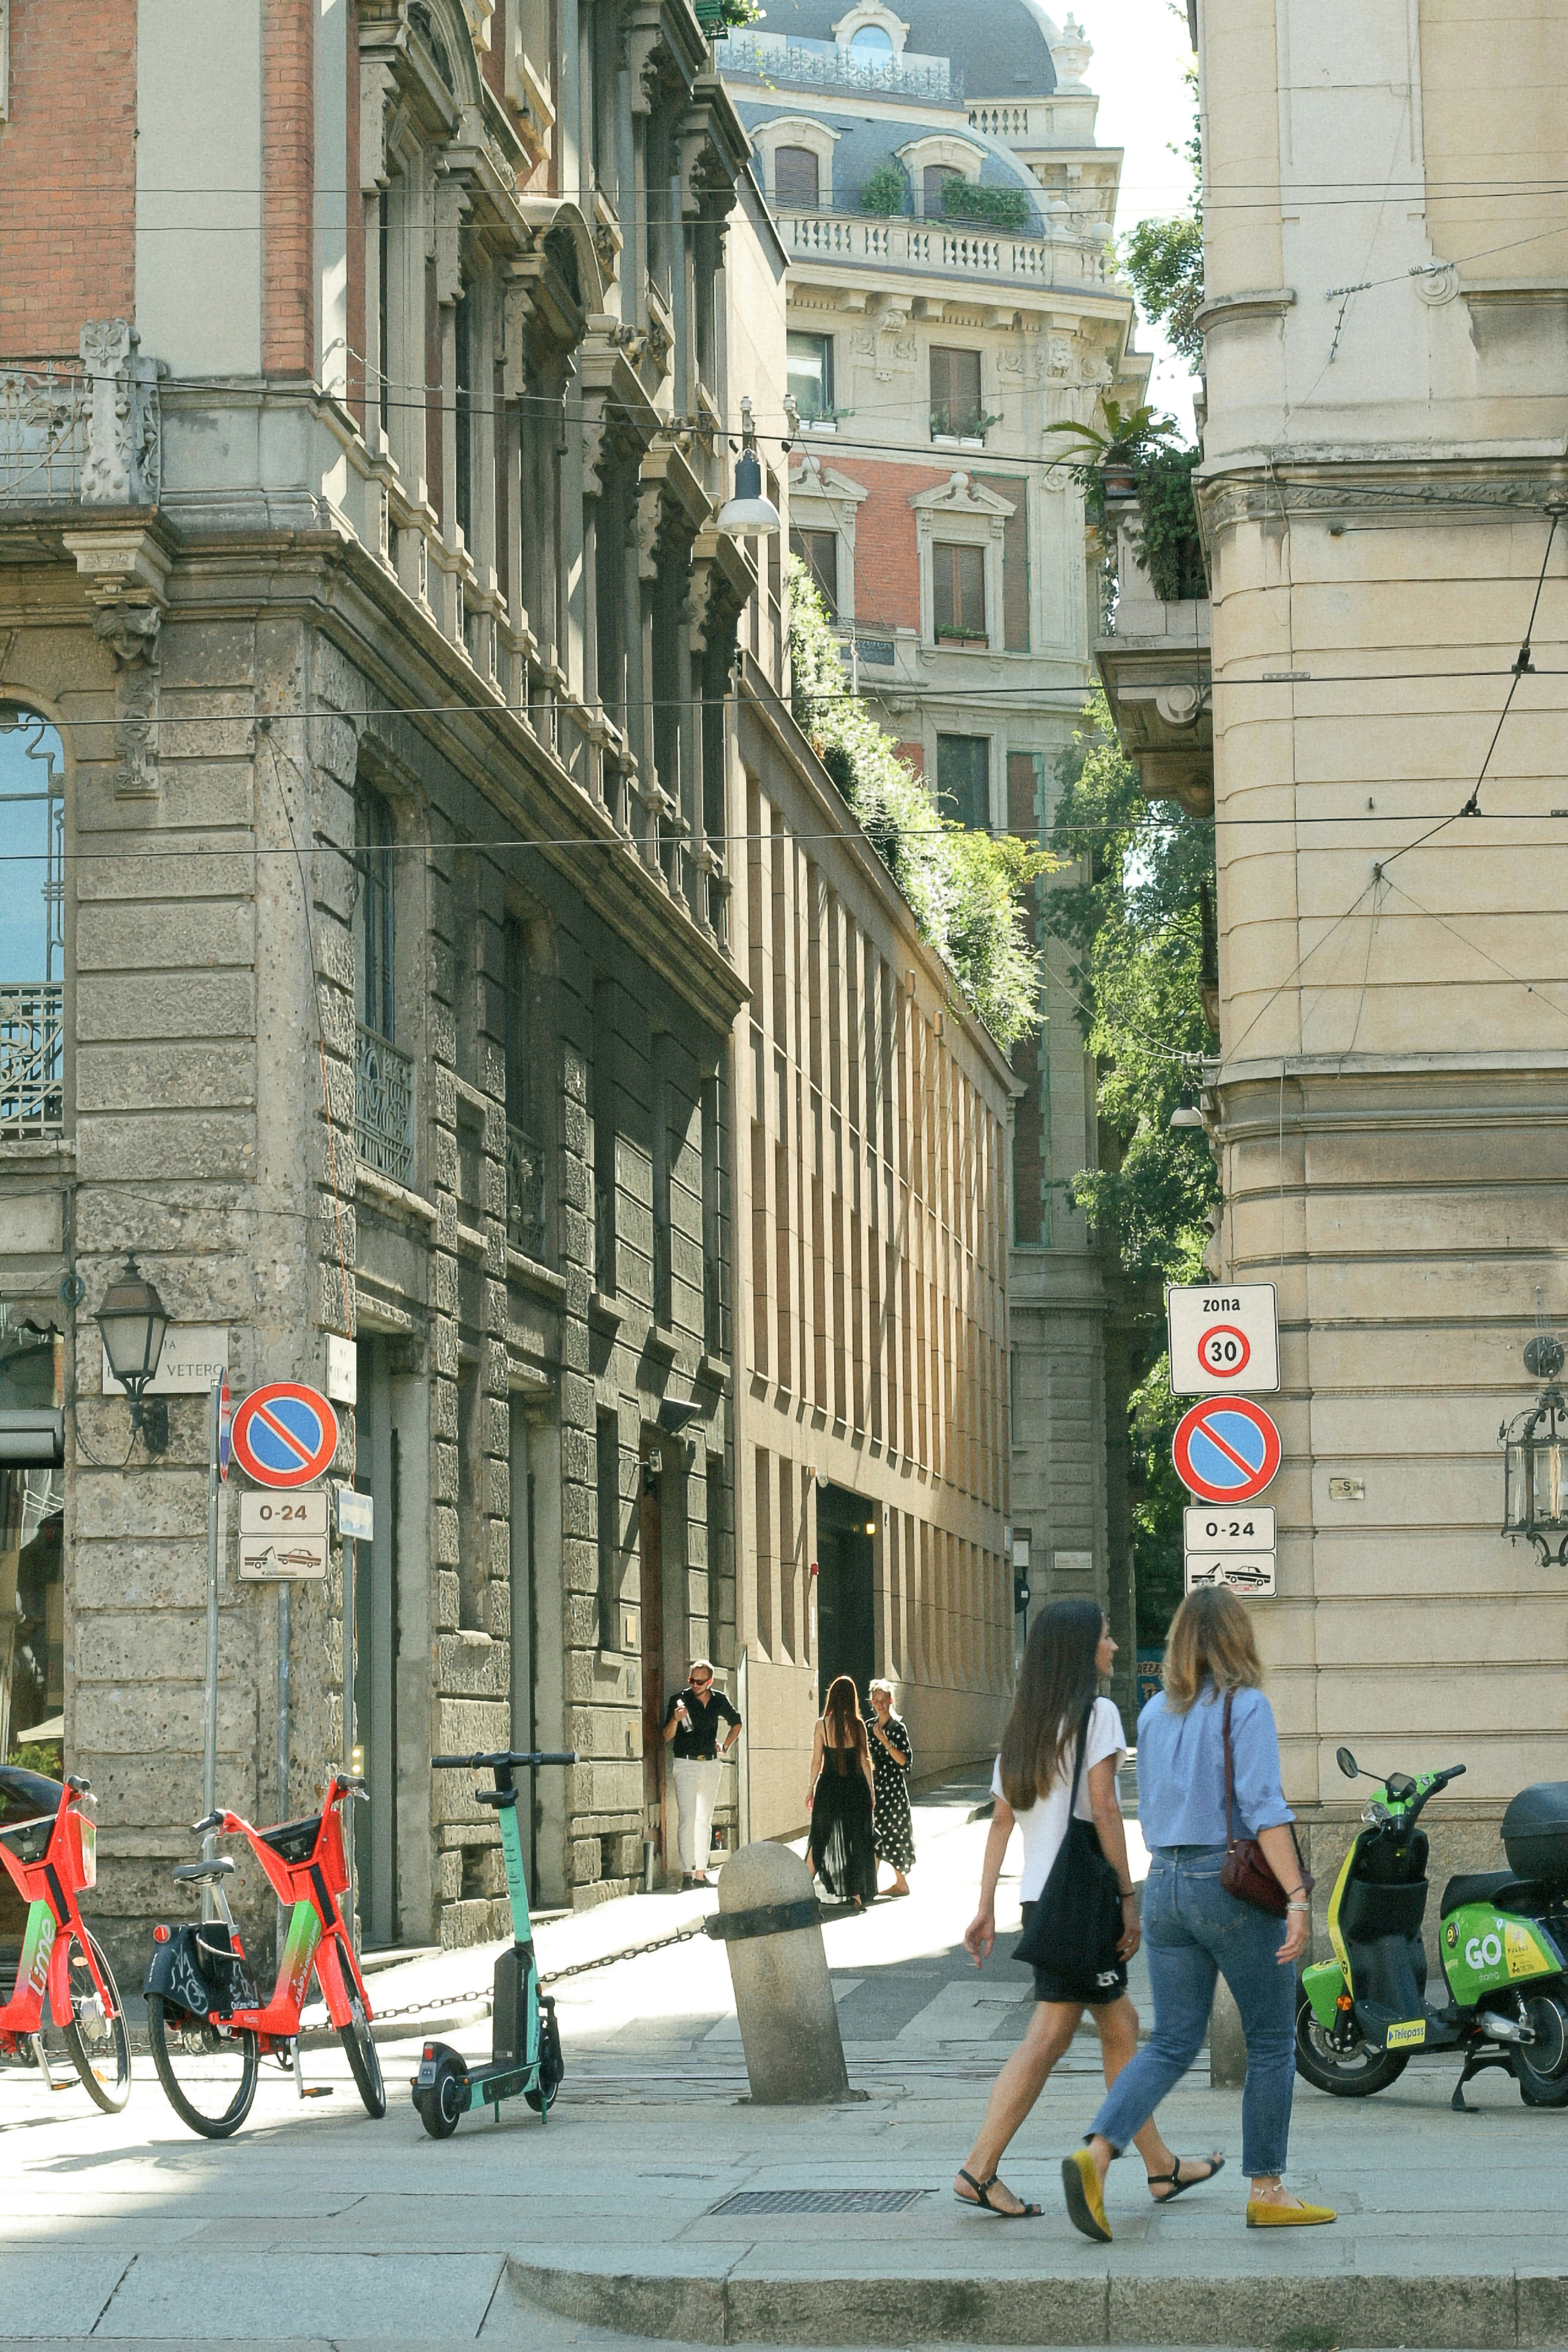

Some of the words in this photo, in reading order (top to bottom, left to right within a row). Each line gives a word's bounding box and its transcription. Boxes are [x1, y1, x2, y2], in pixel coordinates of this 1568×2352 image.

[1203, 1299, 1241, 1312] zona
[163, 1339, 176, 1349] IA
[1211, 1341, 1237, 1362] 30
[167, 1363, 223, 1377] VETERO
[259, 1505, 307, 1520] 0-24
[1206, 1522, 1255, 1537] 0-24
[29, 1918, 55, 1997] Lime
[1465, 1933, 1502, 1970] GO
[1395, 2027, 1424, 2041] Telepass
